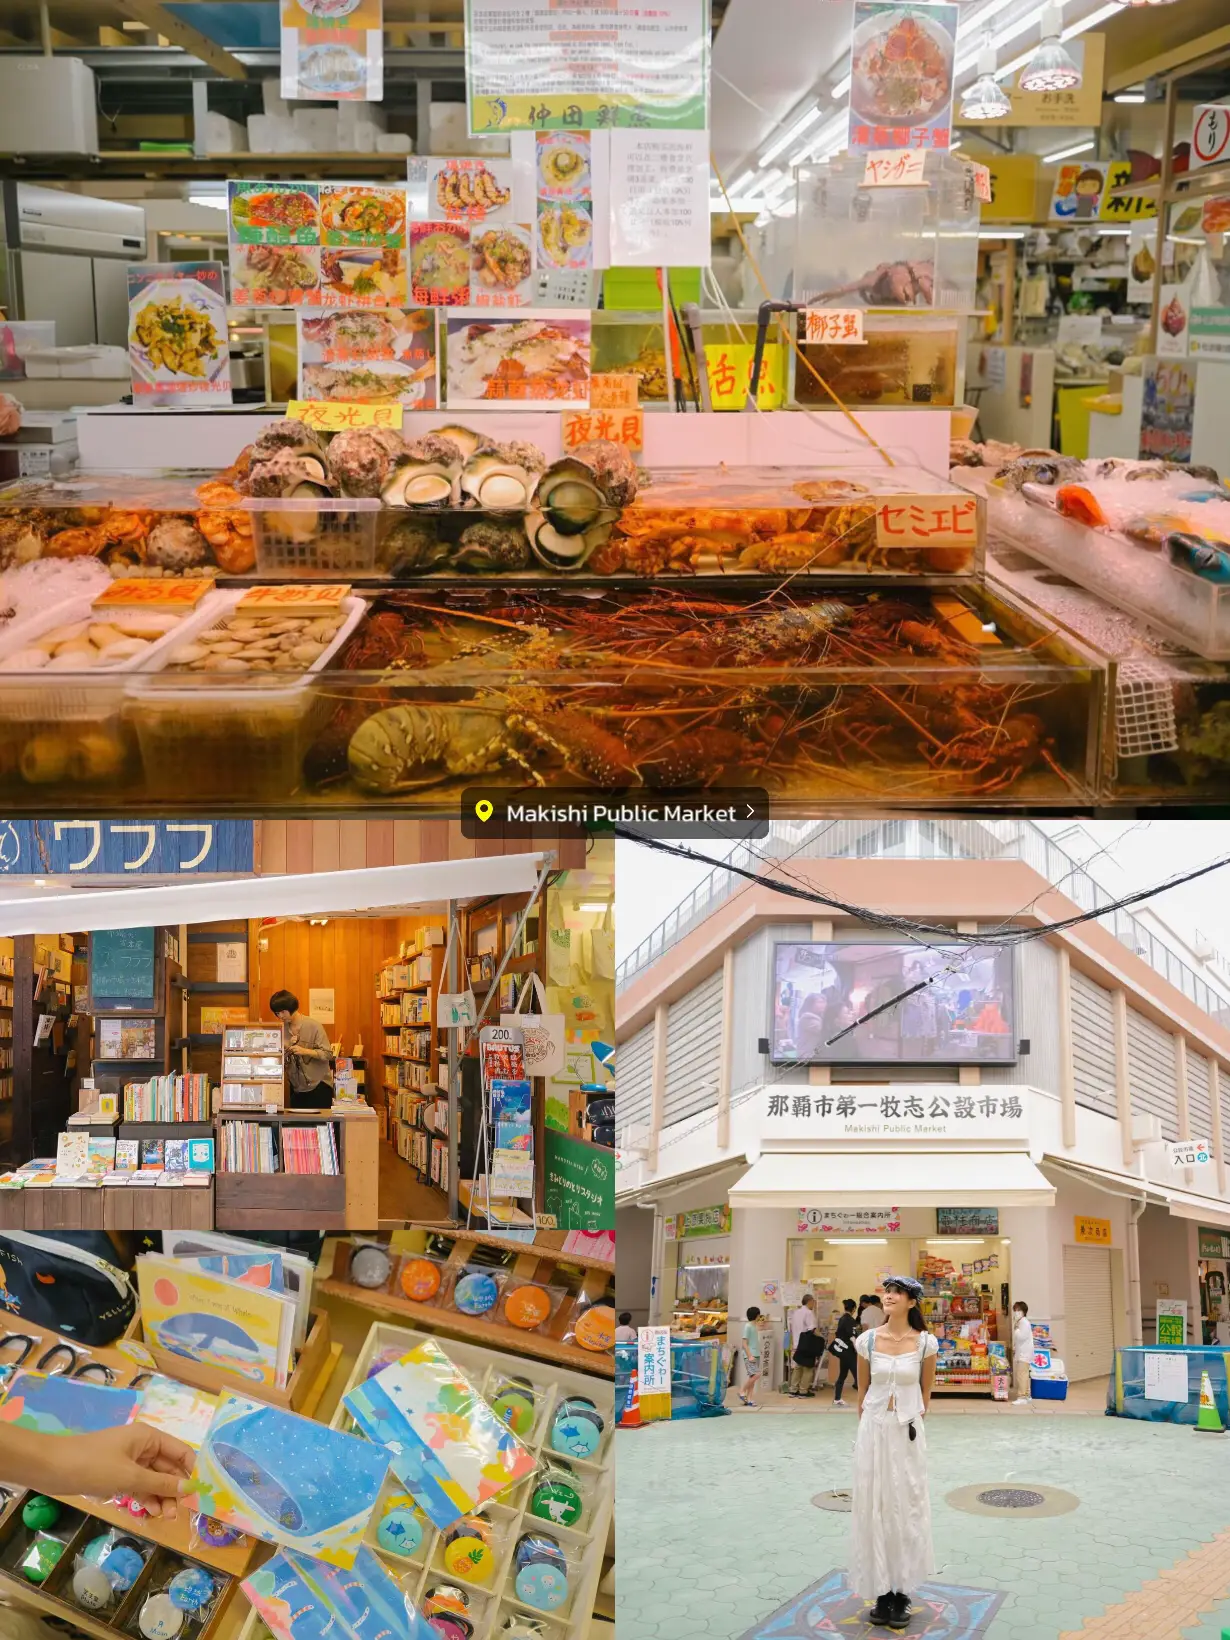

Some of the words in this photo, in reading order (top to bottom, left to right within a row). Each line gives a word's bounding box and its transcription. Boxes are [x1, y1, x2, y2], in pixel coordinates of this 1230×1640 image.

[806, 311, 859, 340] 椰子蟹
[300, 406, 394, 427] 夜光貝
[565, 414, 642, 447] 夜光貝
[878, 500, 976, 537] セミエビ
[766, 1094, 1024, 1120] 那覇市第一牧志公設市場
[844, 1124, 881, 1133] Makishi
[883, 1124, 912, 1133] Public
[914, 1124, 947, 1133] Market
[1174, 1153, 1196, 1165] 入口
[643, 1353, 655, 1386] 案内所
